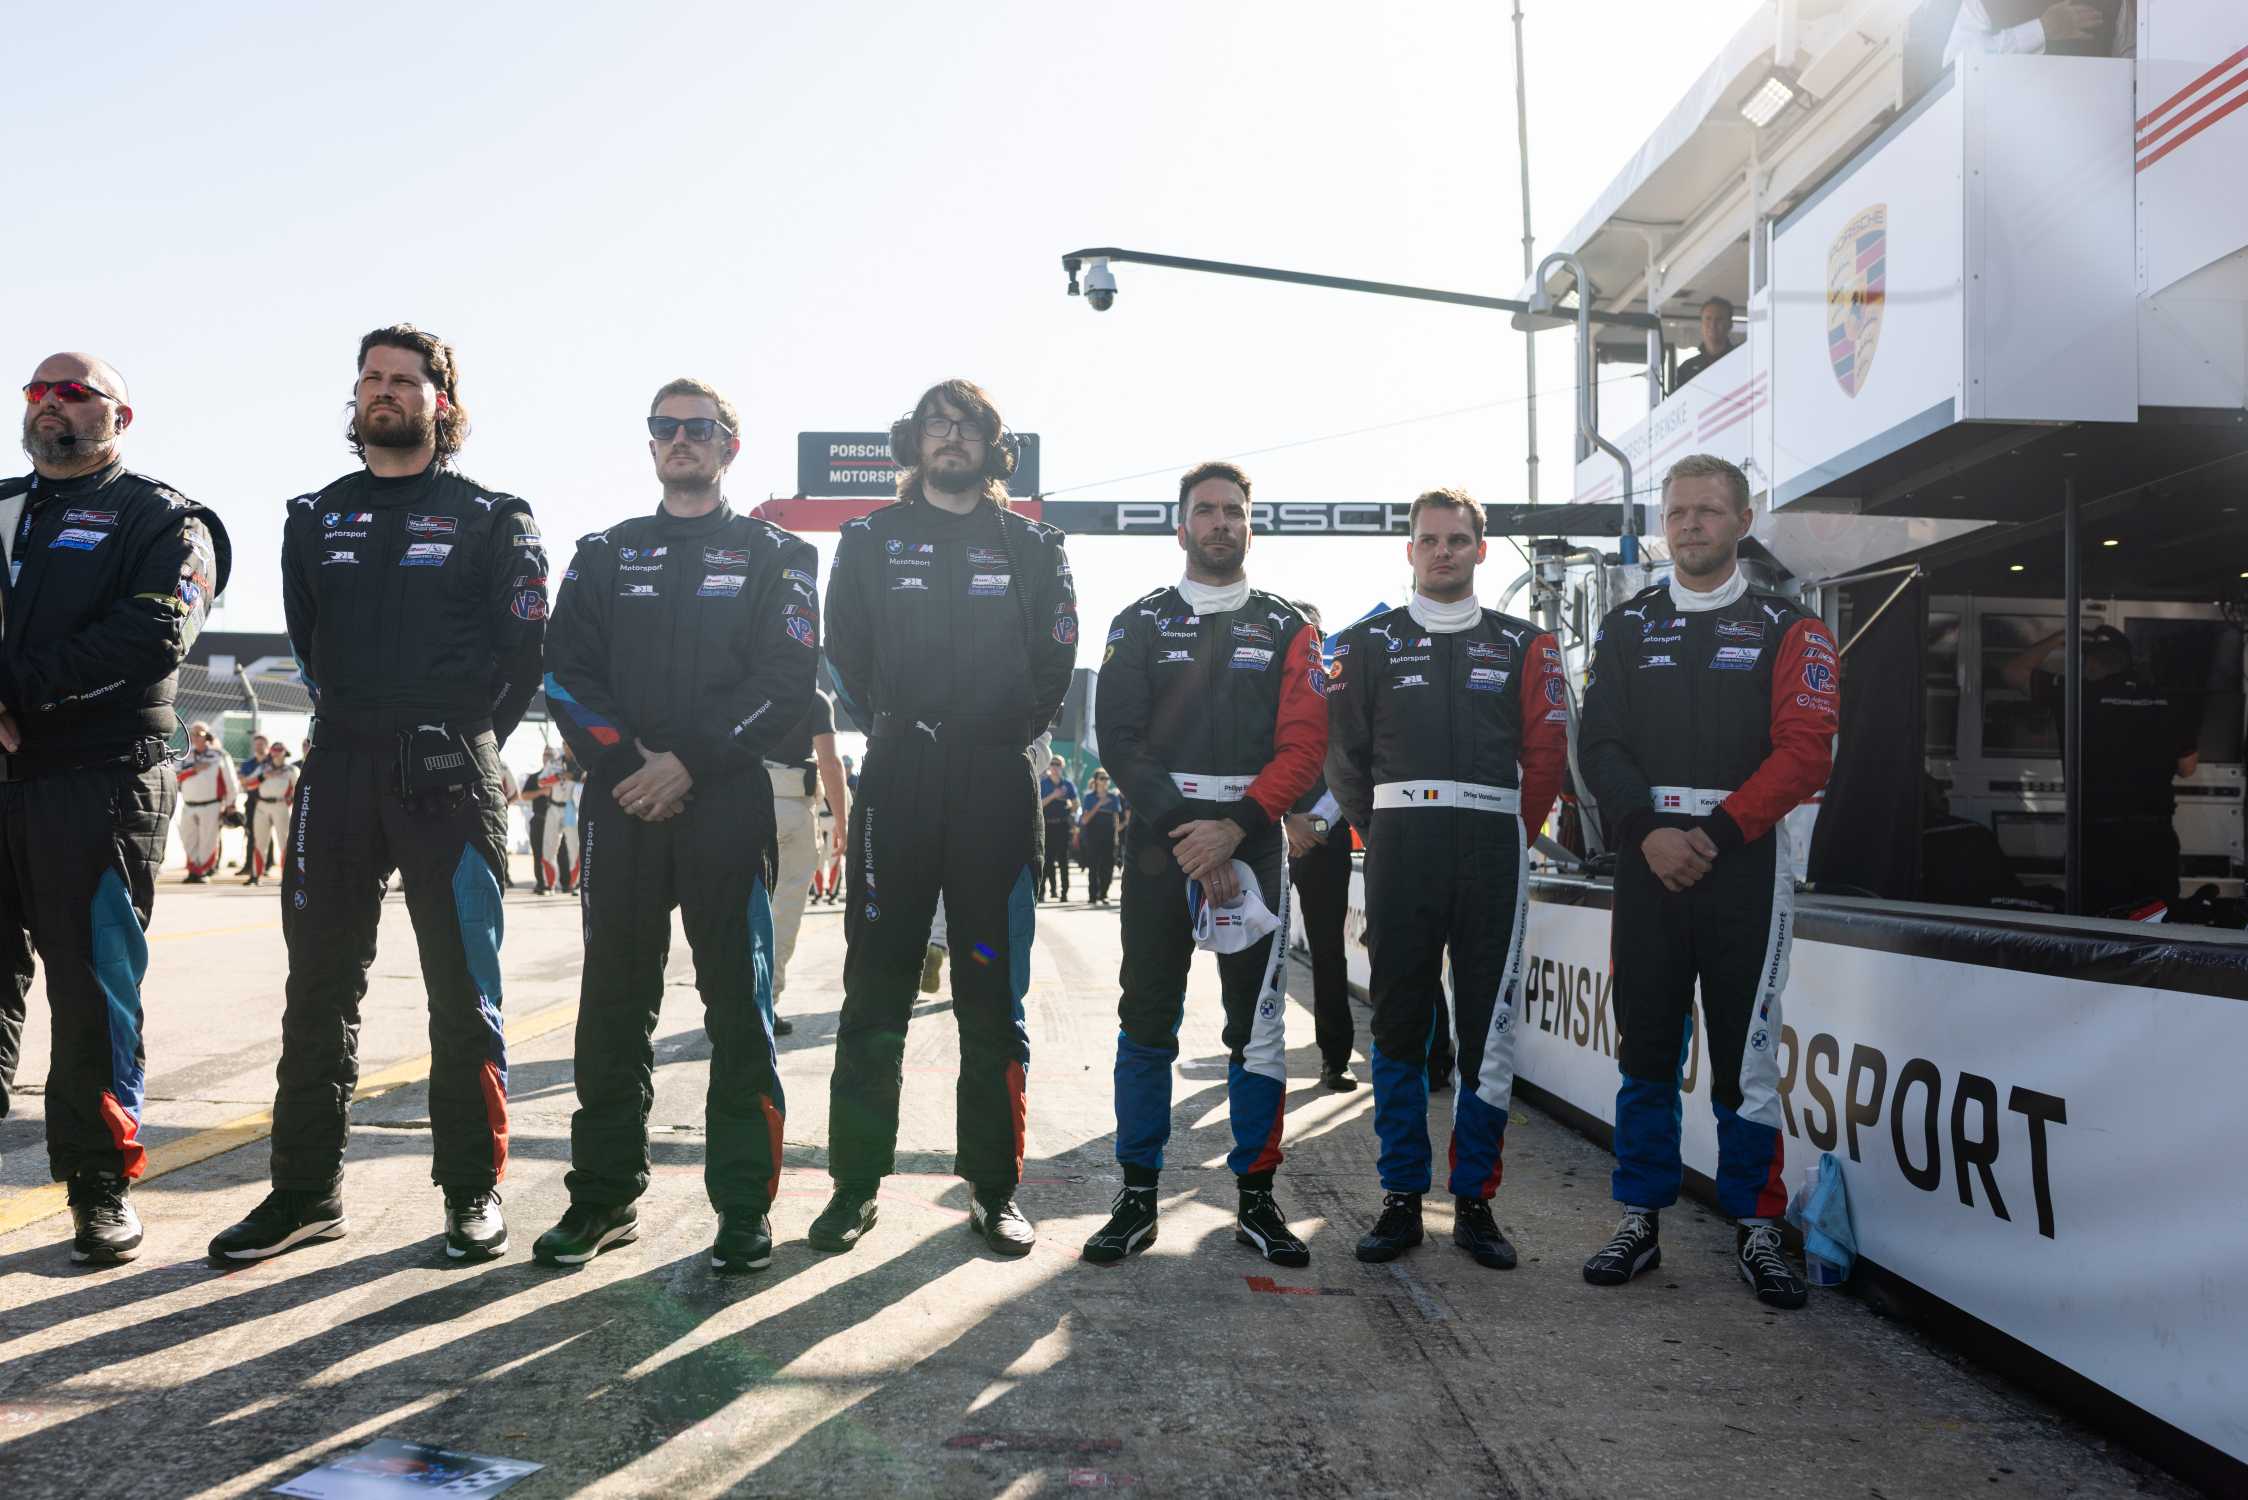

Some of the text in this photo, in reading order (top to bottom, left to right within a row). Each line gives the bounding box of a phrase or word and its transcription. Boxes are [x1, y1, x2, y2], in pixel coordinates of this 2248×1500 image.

[830, 470, 895, 482] MOTORSP
[1117, 503, 1487, 531] PRSCH
[1161, 631, 1198, 639] otorsport
[1642, 634, 1681, 644] otorsport
[296, 785, 311, 853] Motorsport
[863, 806, 875, 869] Motorsport
[583, 821, 595, 888] Motorsport
[1767, 911, 1787, 988] Motorsport
